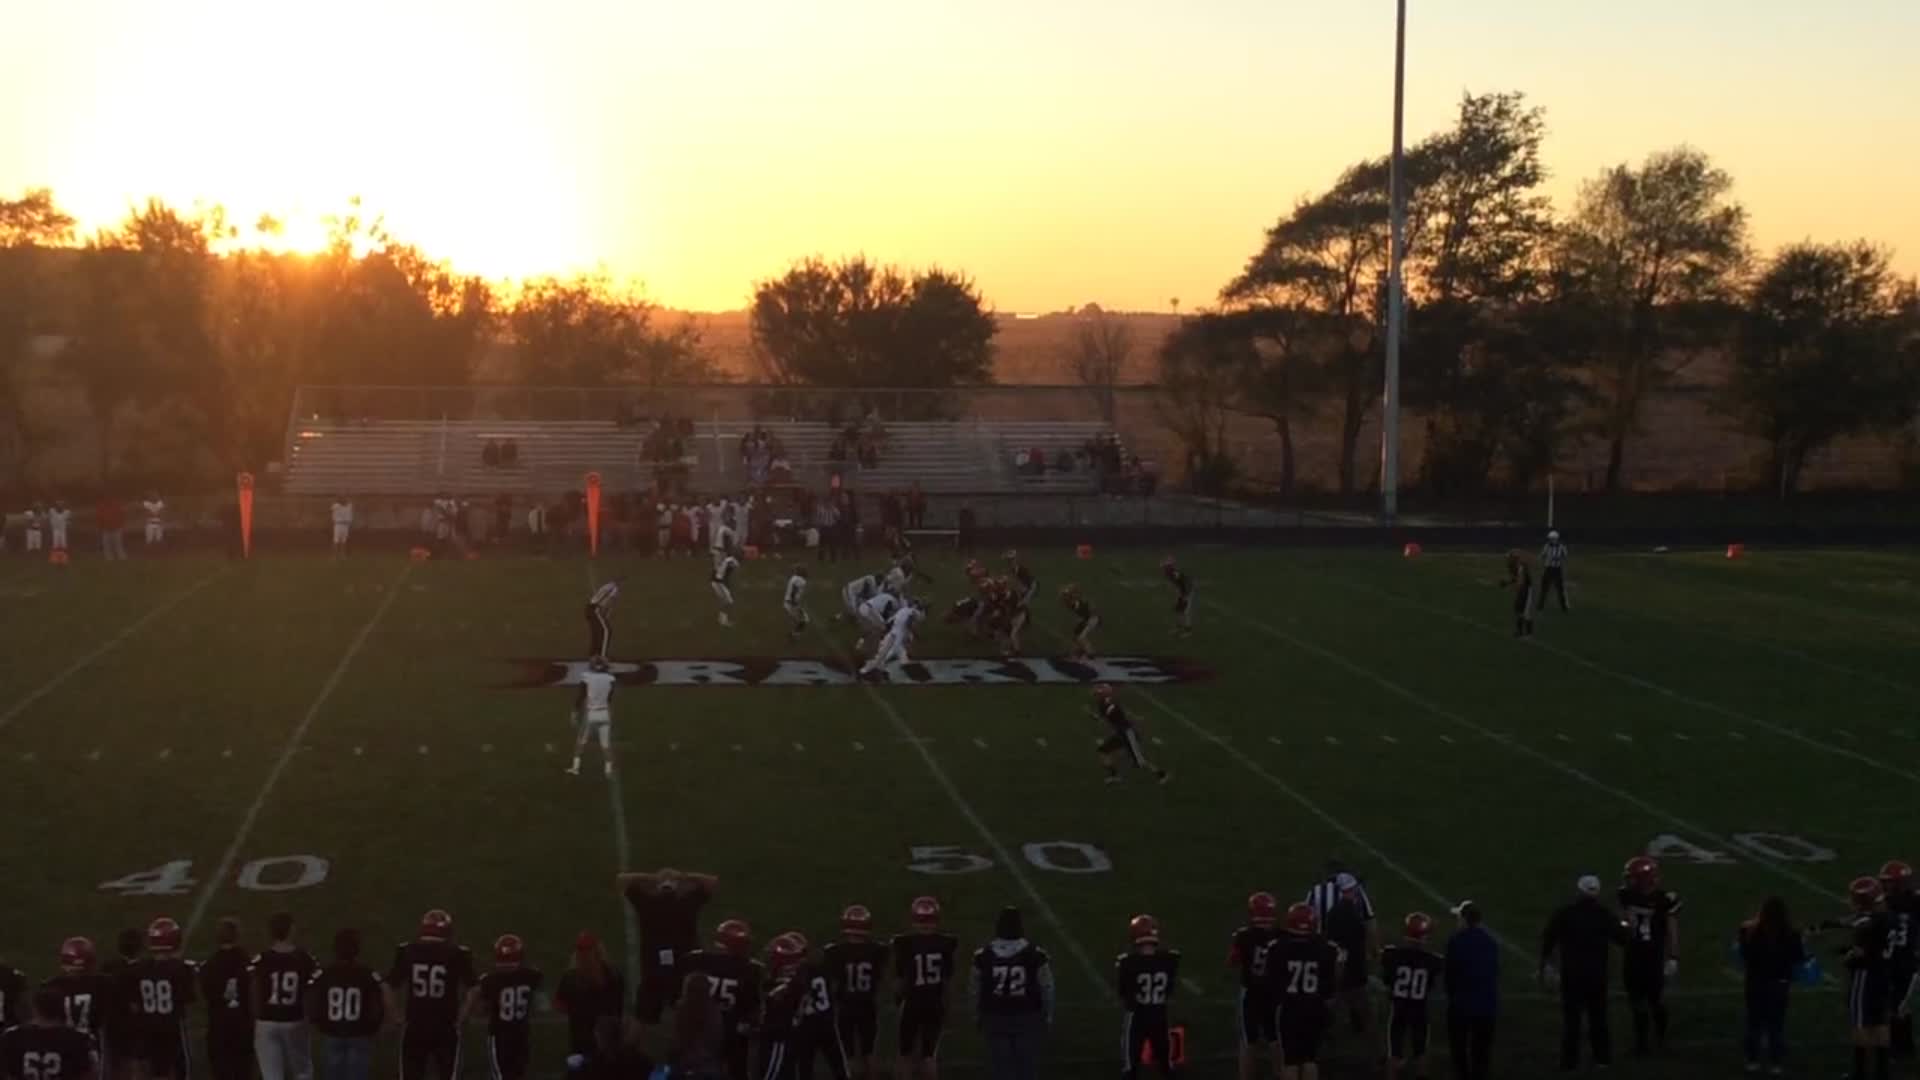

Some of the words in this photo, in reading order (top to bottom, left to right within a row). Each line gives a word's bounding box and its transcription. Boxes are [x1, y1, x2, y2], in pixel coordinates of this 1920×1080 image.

[97, 855, 330, 895] 40
[907, 842, 1112, 874] 50
[411, 964, 447, 998] 56
[845, 962, 873, 992] 16
[914, 953, 942, 986] 15
[992, 966, 1026, 996] 72
[1287, 960, 1319, 993] 76
[1393, 966, 1428, 1000] 20
[139, 978, 173, 1014] 88
[268, 971, 299, 1005] 19
[327, 987, 361, 1021] 80
[500, 985, 530, 1021] 85
[706, 975, 738, 1009] 75
[1136, 972, 1168, 1005] 32
